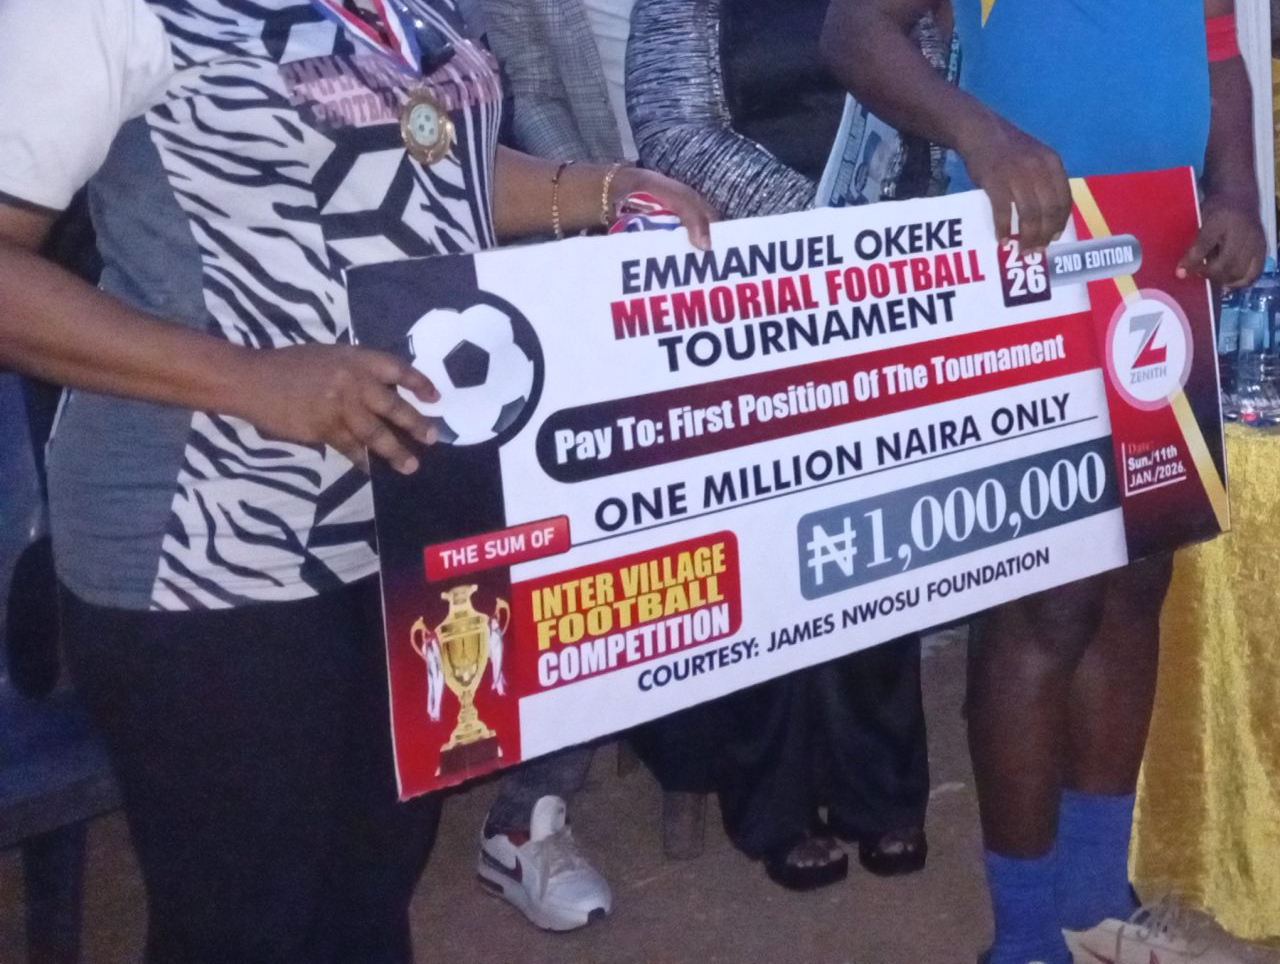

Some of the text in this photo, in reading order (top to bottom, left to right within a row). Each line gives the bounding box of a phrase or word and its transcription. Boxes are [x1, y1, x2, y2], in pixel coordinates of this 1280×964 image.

[610, 248, 985, 340] MEMORIAL FOOTBALL
[621, 217, 963, 295] EMMANUEL OKEKE
[1006, 264, 1047, 297] 26
[1054, 245, 1134, 274] 2ND EDITION
[658, 289, 957, 372] TOURNAMENT
[554, 334, 1067, 464] Pay To: First Position Of The Tournament
[1130, 366, 1168, 384] ZENITH
[594, 393, 1071, 532] ONE MILLION NAIRA ONLY
[439, 527, 555, 570] THE SUM OF
[531, 541, 727, 622] INTER VILLAGE
[536, 575, 725, 651] FOOTBALL
[537, 602, 730, 688] COMPETITION
[637, 546, 1050, 692] COURTESY: JAMES NWOSU FOUNDATION
